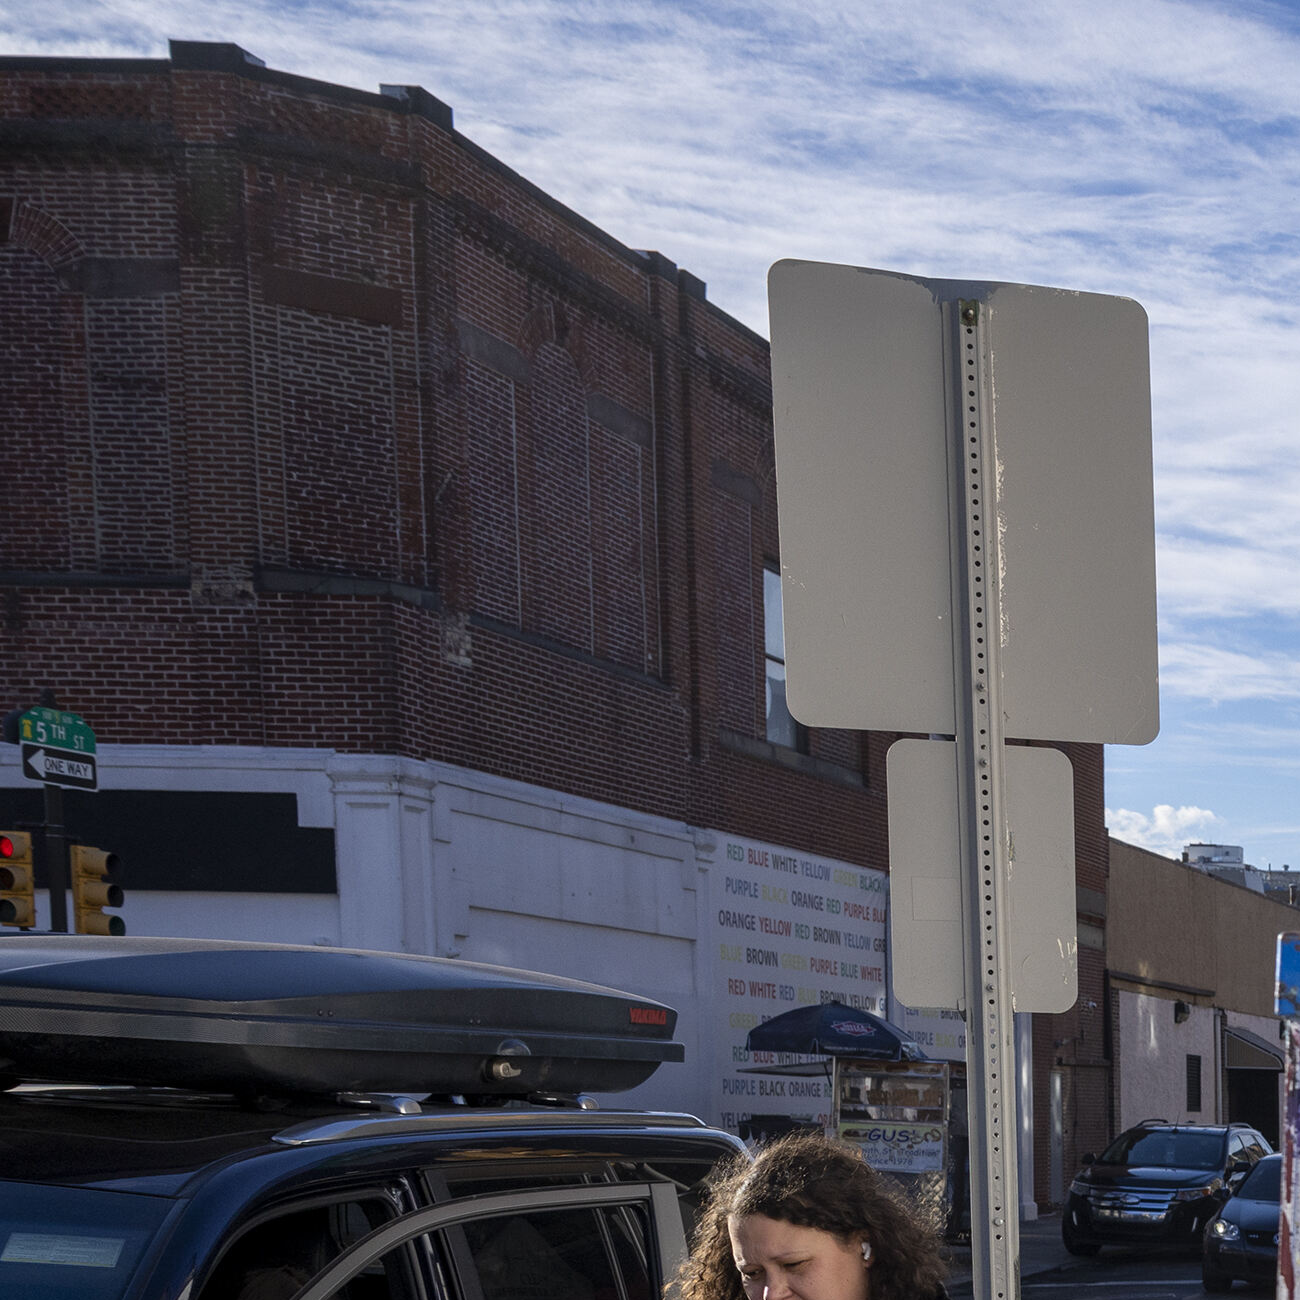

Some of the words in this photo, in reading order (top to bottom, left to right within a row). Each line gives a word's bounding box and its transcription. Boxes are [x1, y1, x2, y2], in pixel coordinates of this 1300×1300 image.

[73, 735, 85, 750] ST
[44, 758, 65, 773] ONE
[67, 762, 89, 777] WAY
[727, 843, 744, 862] RED
[748, 848, 769, 868] BLUE
[772, 853, 798, 874] WHITE
[800, 861, 831, 882] YELLOW
[860, 875, 882, 893] BLACK
[725, 876, 759, 898] PURPLE
[791, 890, 824, 912] ORANGE
[826, 897, 841, 915] RED
[843, 902, 870, 921] PURPLE
[872, 908, 886, 924] BLU
[718, 909, 756, 931] ORANGE
[759, 916, 792, 937] YELLOW
[795, 923, 810, 939] RED
[813, 926, 841, 946] BROWN
[843, 932, 871, 950] YELLOW
[720, 944, 742, 962] BLUE
[746, 948, 778, 967] BROWN
[810, 957, 838, 977] PURPLE
[840, 963, 858, 979] BLUE
[860, 966, 882, 982] WHITE
[728, 978, 746, 996] RED
[749, 981, 777, 999] WHITE
[779, 985, 795, 1001] RED
[820, 990, 847, 1006] BROWN
[850, 994, 877, 1011] YELLOW
[629, 1007, 667, 1025] YAKIMA
[732, 1046, 749, 1063] RED
[753, 1050, 775, 1064] BLUE
[722, 1078, 756, 1096] PURPLE
[759, 1080, 786, 1097] BLACK
[788, 1081, 821, 1098] ORANGE
